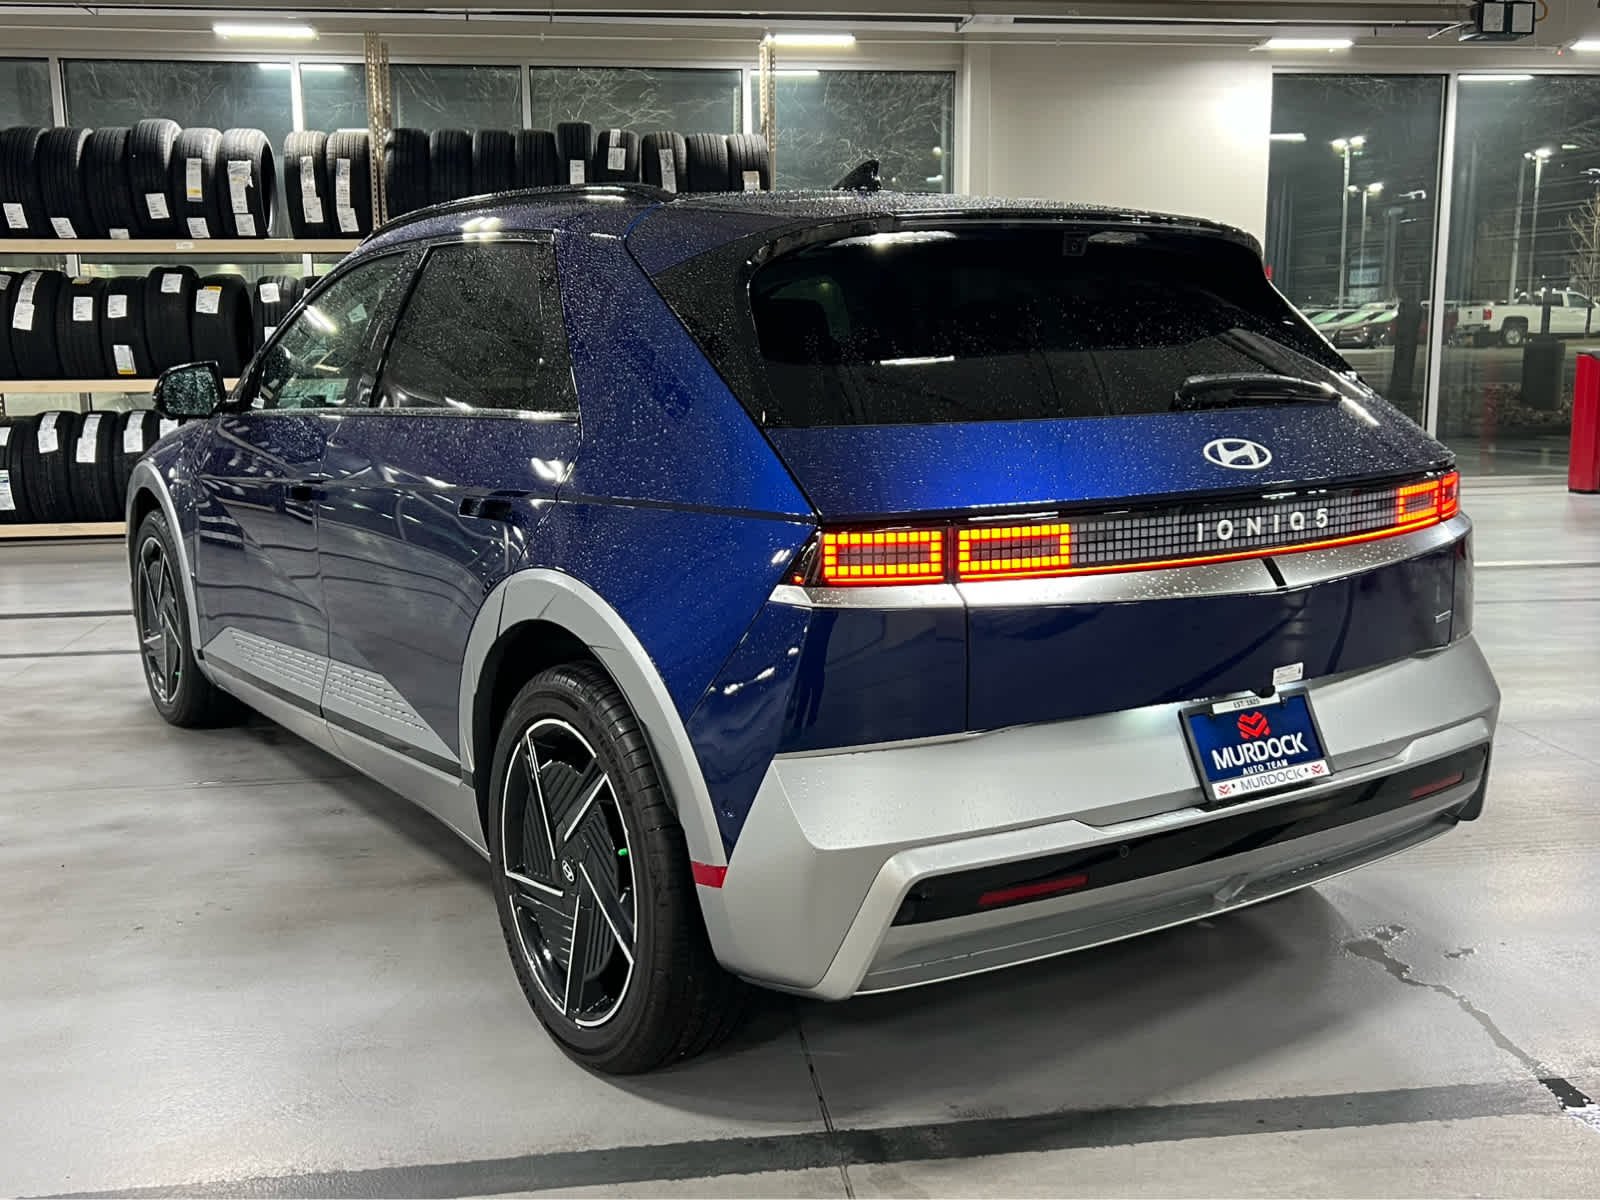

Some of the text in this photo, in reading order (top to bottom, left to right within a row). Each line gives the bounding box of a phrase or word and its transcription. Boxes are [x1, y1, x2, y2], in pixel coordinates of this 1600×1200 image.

[1211, 732, 1309, 770] MURDOCK
[1242, 758, 1289, 776] AUTO TEAM
[1240, 768, 1304, 792] MURDOCK
